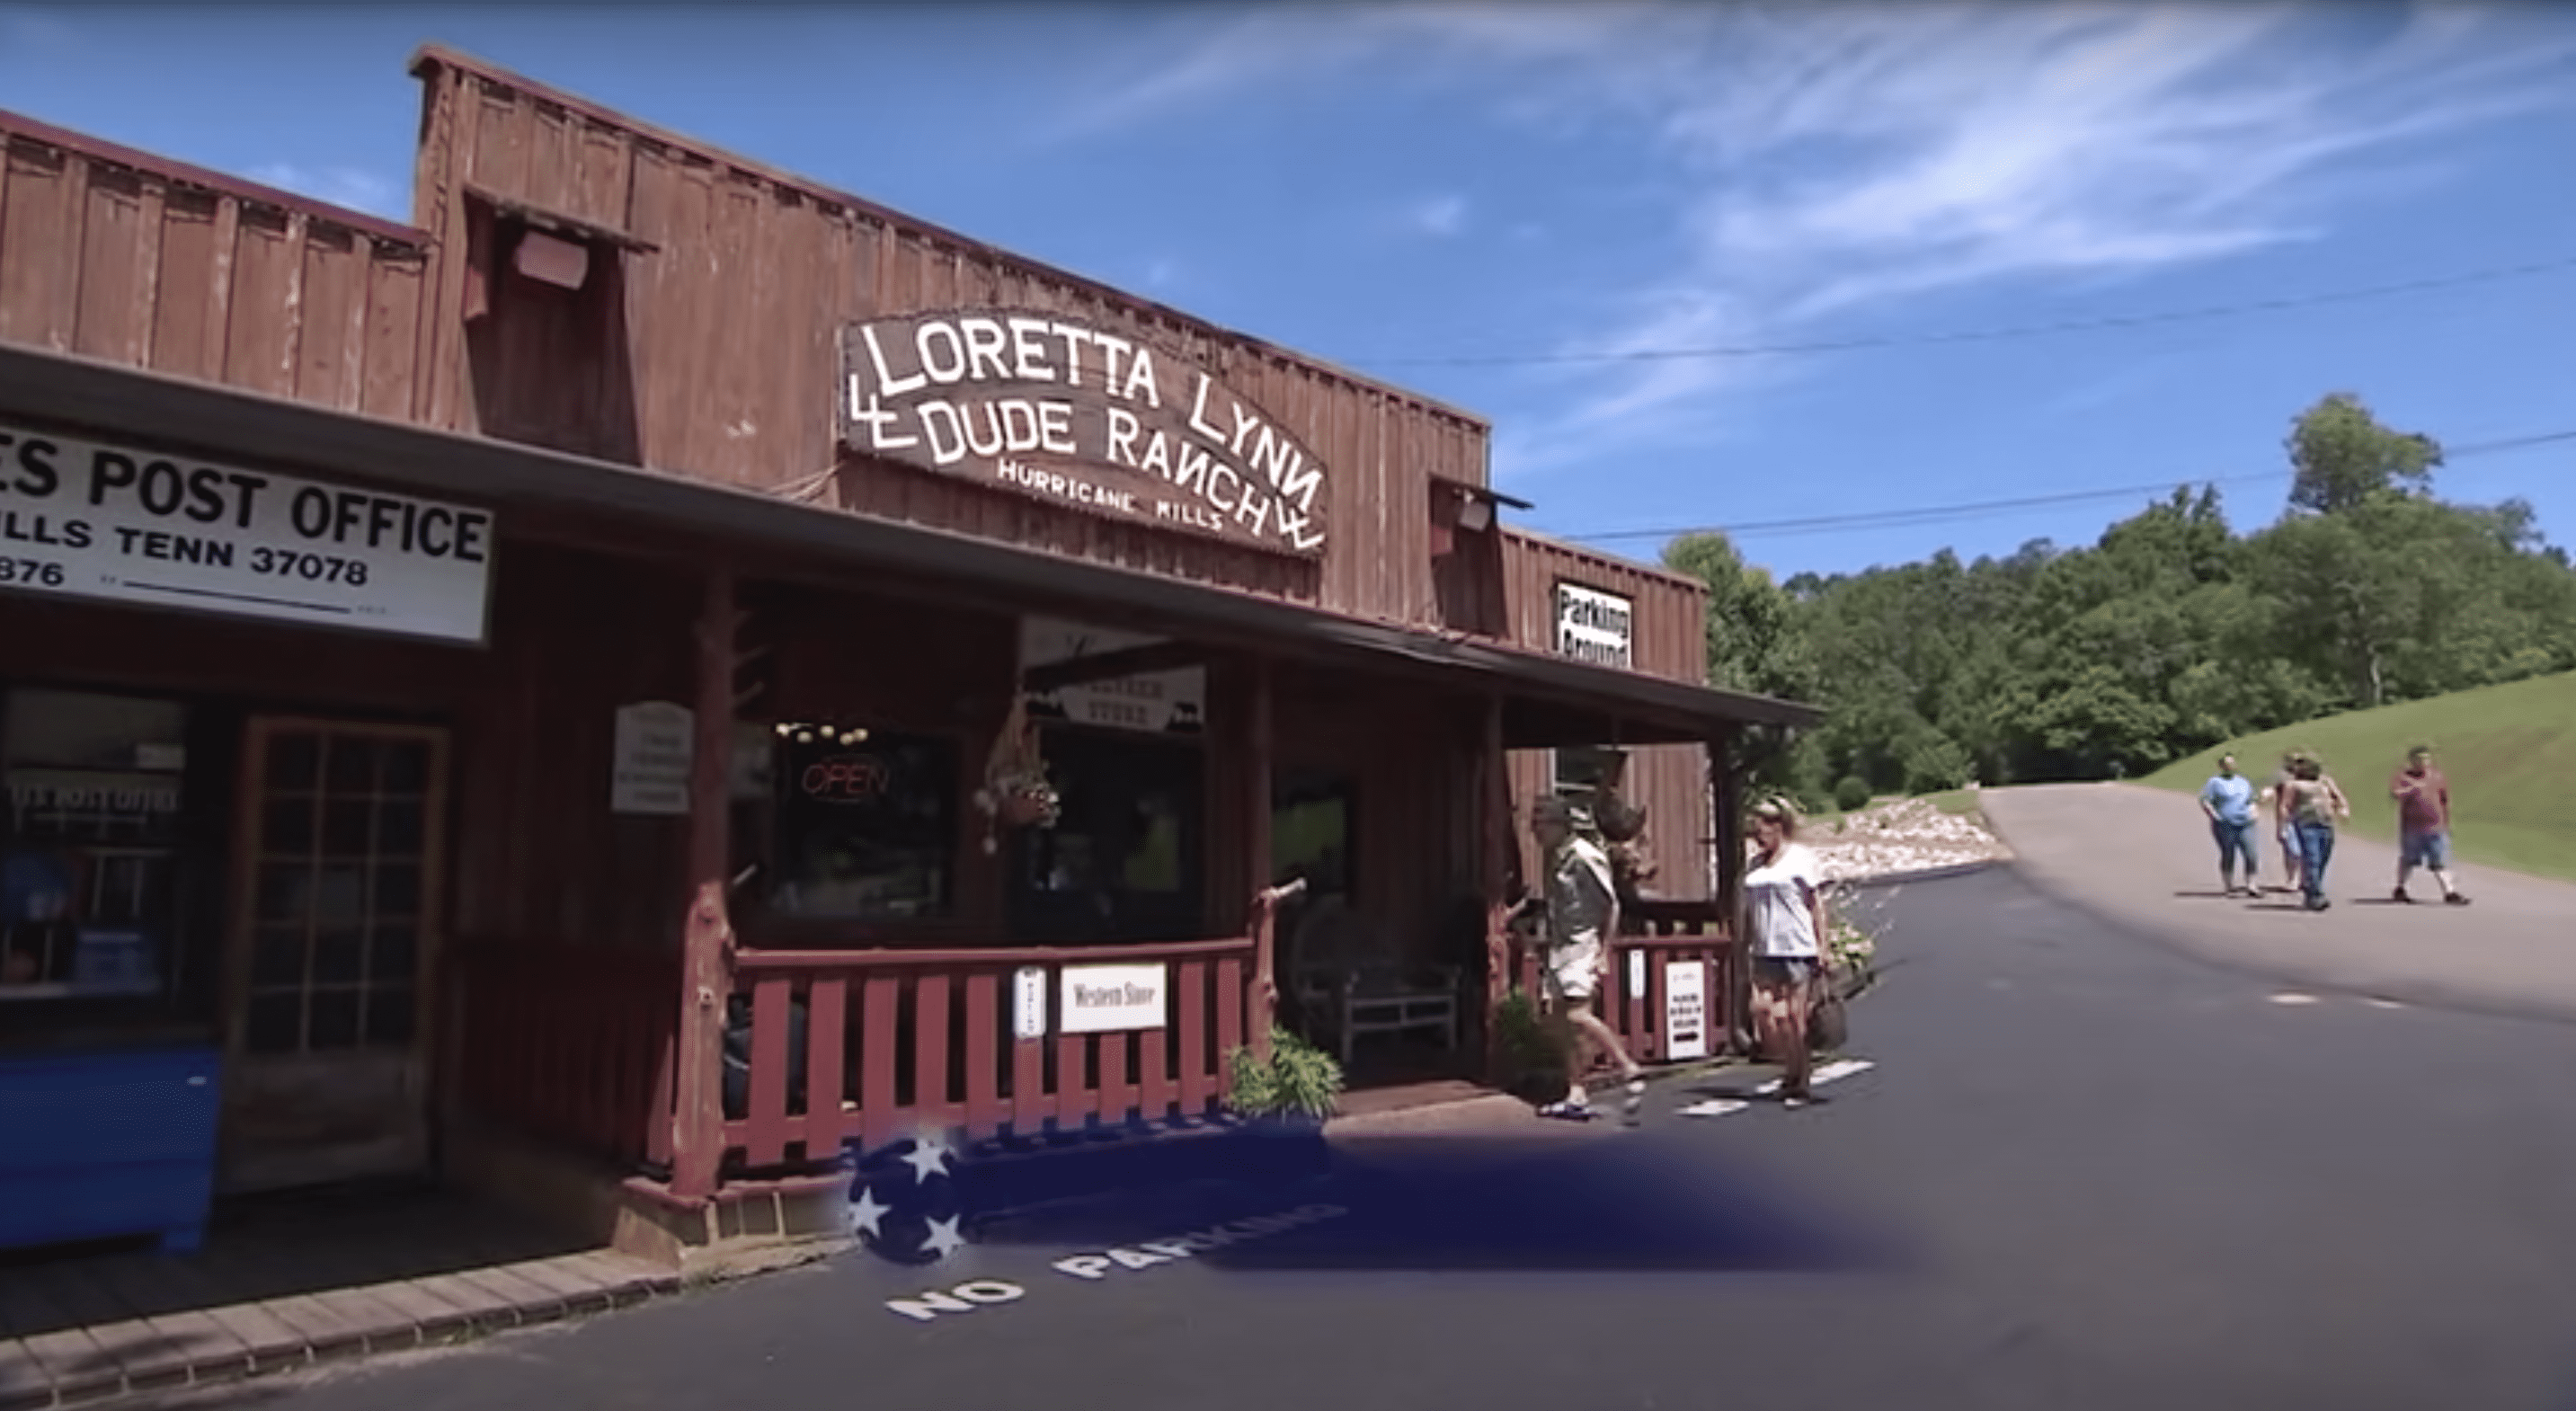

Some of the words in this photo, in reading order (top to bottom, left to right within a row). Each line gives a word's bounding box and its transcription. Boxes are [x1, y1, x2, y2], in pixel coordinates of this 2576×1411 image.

[860, 317, 1159, 408] LORETTA
[1189, 370, 1324, 514] LYNN
[89, 449, 269, 529] POST
[290, 485, 487, 564] OFFICE
[917, 400, 1077, 465] DUDE
[1106, 406, 1271, 537] RANCH
[997, 457, 1134, 514] HURRICANE
[1157, 499, 1223, 531] MILLS
[0, 511, 93, 548] LLS
[114, 526, 234, 567] TENN
[250, 546, 369, 587] 37078
[1560, 590, 1629, 639] Parking
[800, 762, 891, 795] OPEN
[1073, 982, 1123, 1007] Western
[884, 1280, 1025, 1320] NO
[1053, 1203, 1349, 1278] PARKING
